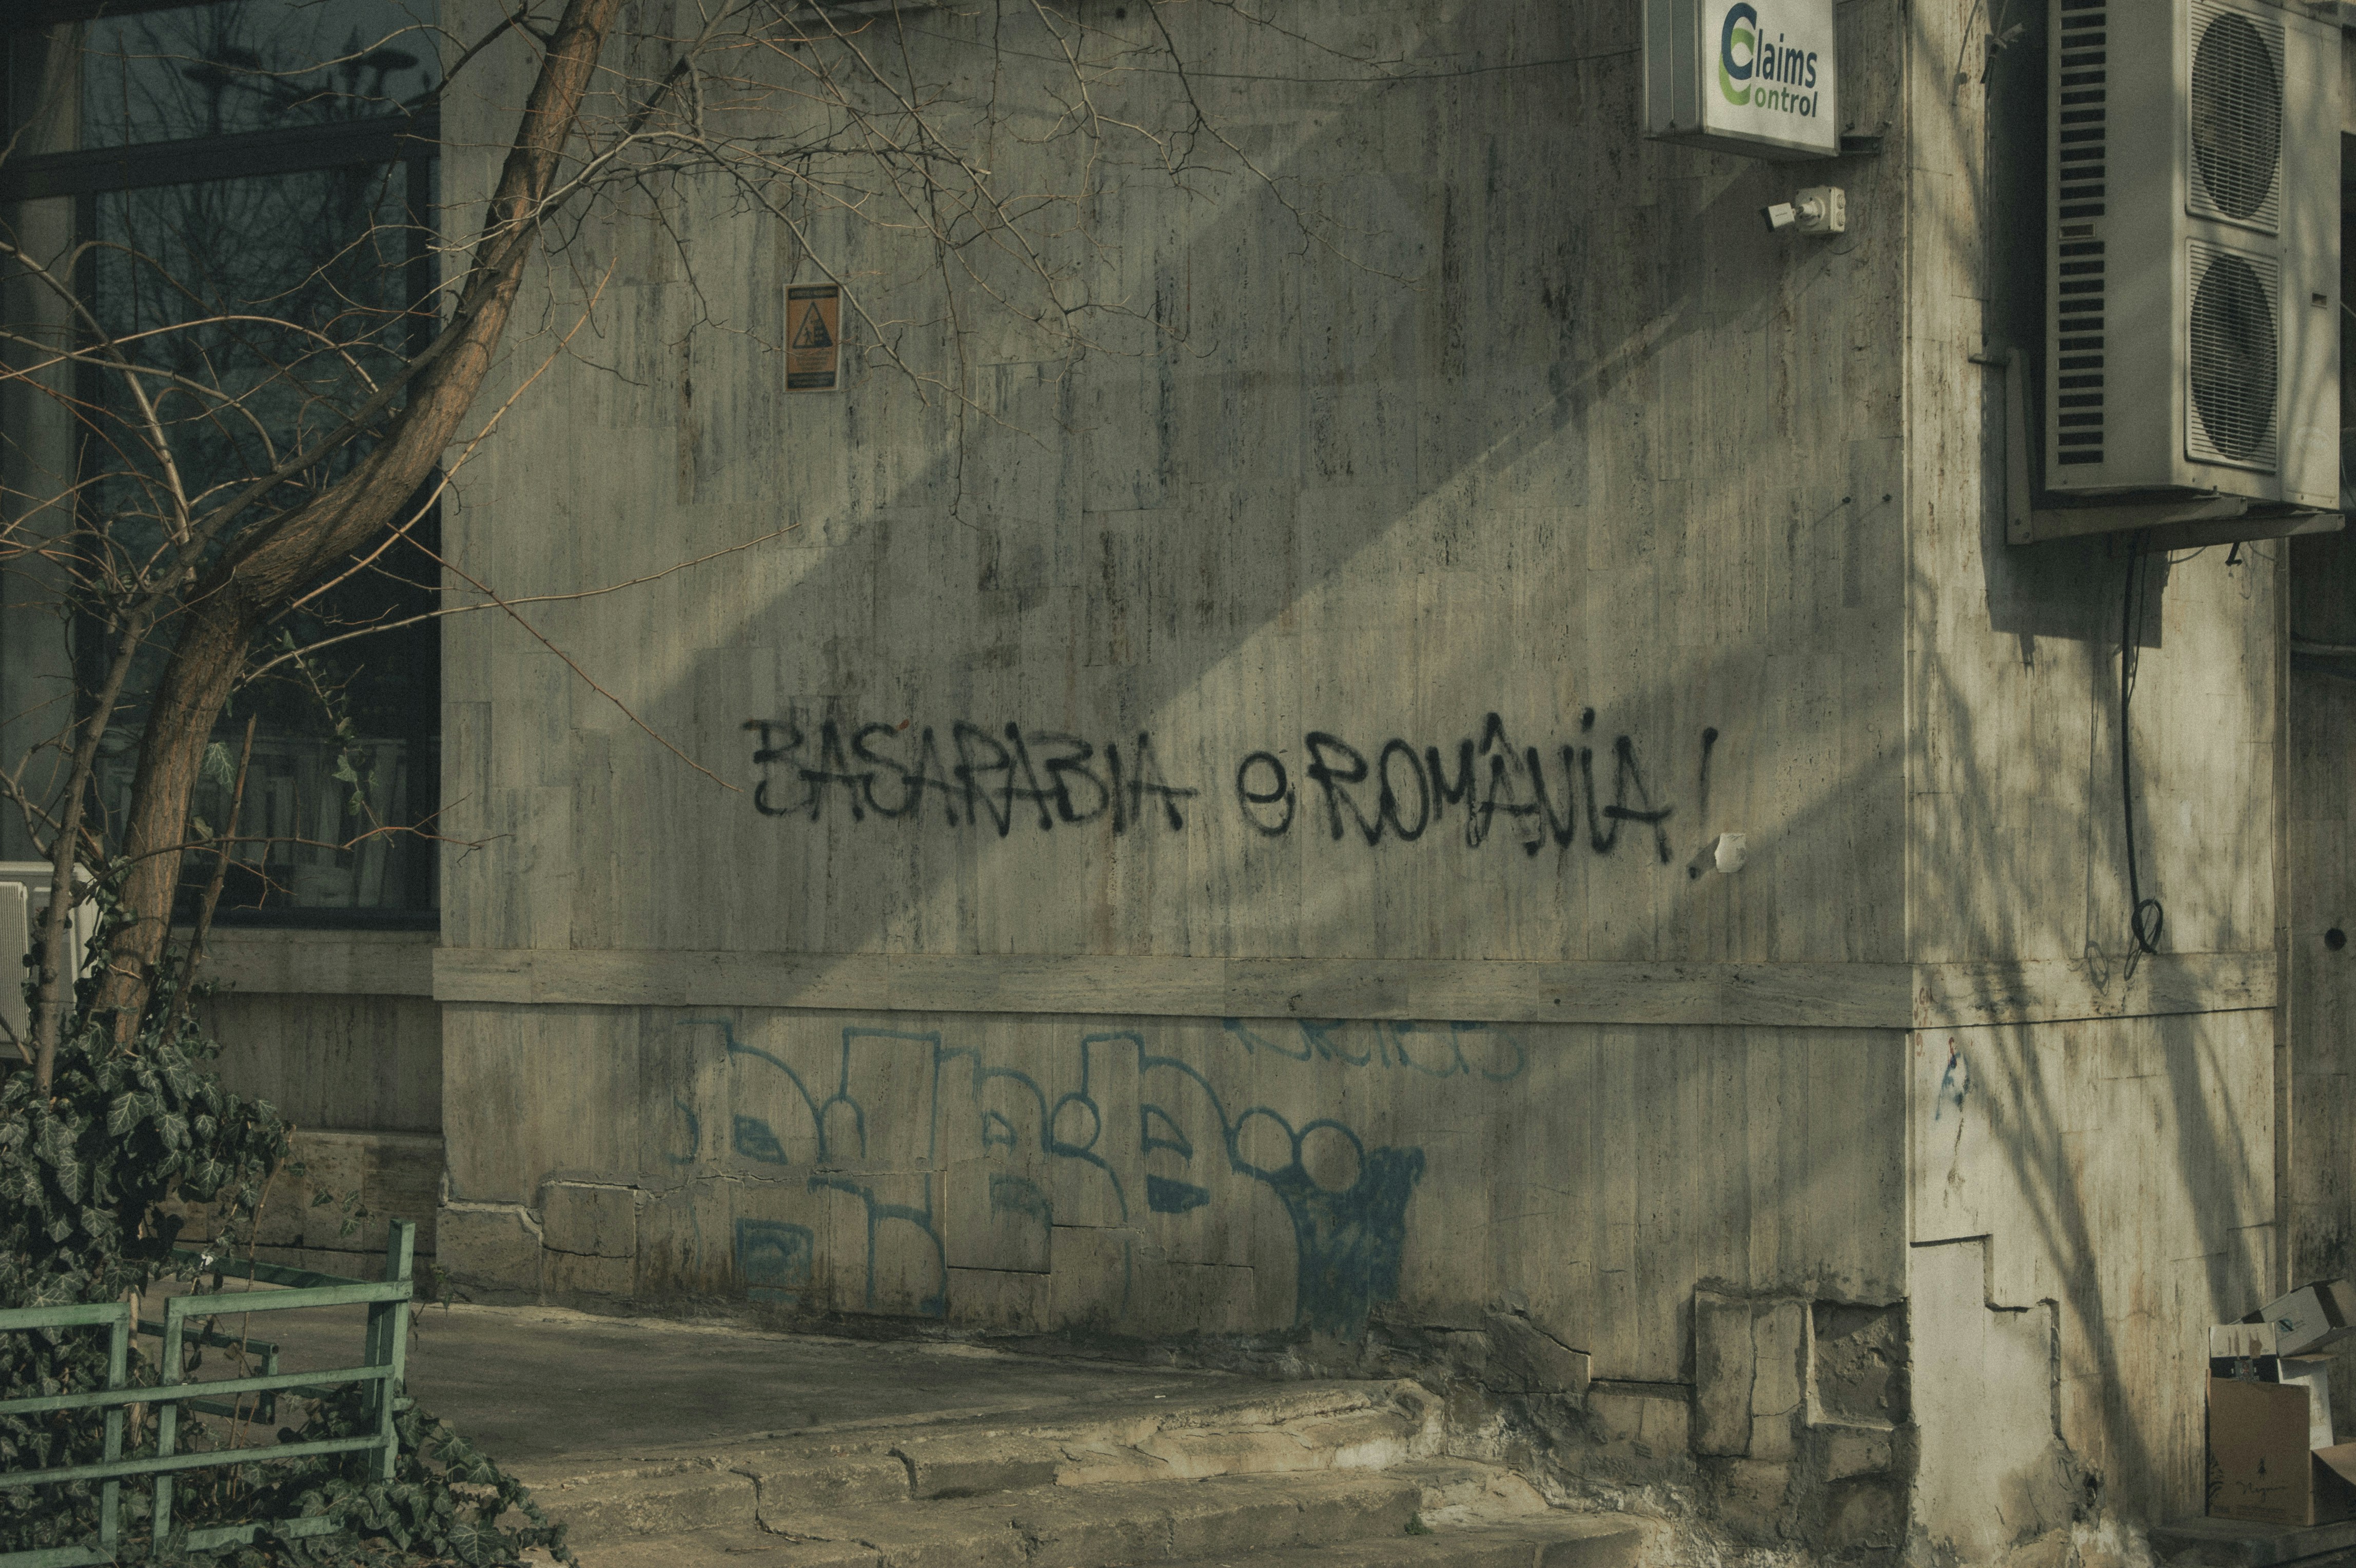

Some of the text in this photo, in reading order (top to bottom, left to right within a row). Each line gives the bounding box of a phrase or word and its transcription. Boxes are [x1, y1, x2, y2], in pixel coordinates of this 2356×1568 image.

[1719, 28, 1818, 117] Control
[1721, 2, 1817, 89] Claims
[743, 719, 1199, 837] BASARABIA
